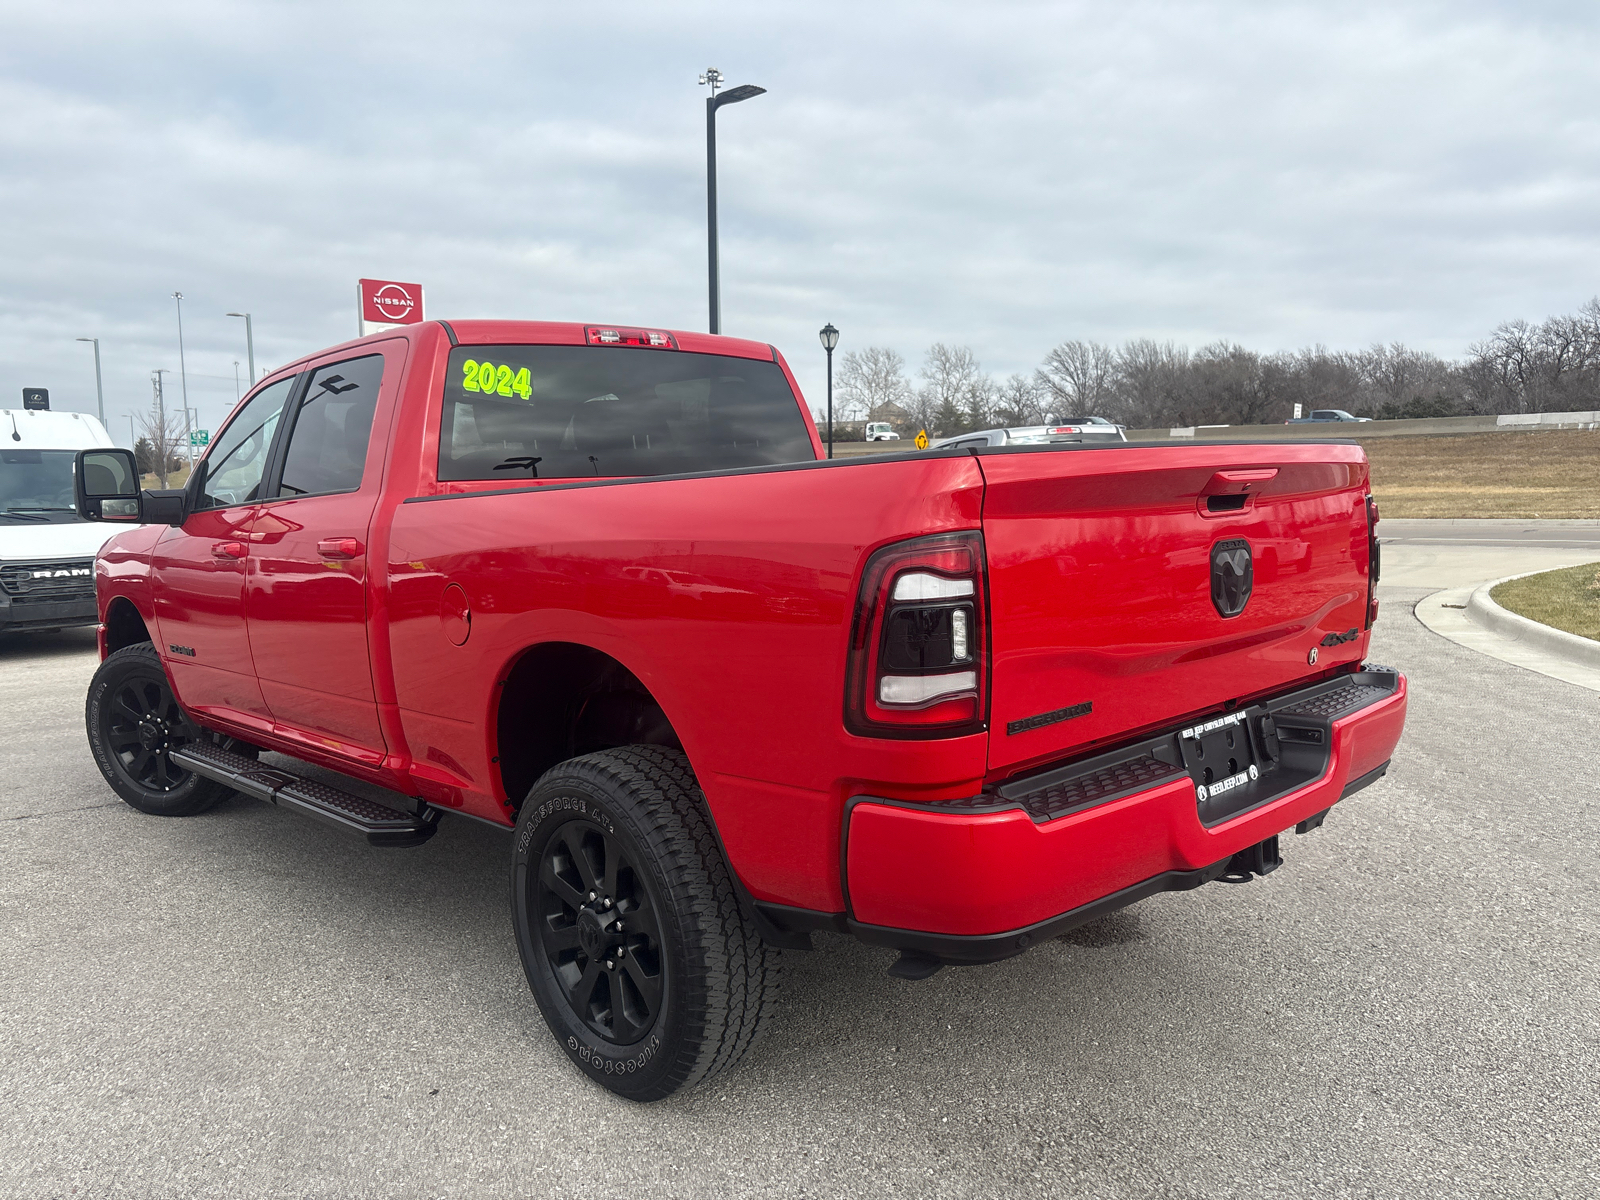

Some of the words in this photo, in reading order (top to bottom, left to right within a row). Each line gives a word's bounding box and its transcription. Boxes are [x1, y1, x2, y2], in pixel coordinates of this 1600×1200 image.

[374, 297, 414, 307] NISSAN
[463, 359, 532, 400] 2024
[1221, 541, 1245, 549] RAM
[33, 569, 90, 578] RAM
[1006, 701, 1093, 736] BIGHORN
[1204, 718, 1225, 731] CHRYSLER
[1224, 713, 1237, 725] DODGE
[1236, 710, 1247, 720] RAM
[1208, 771, 1249, 797] REEDJEEP.COM
[518, 797, 587, 855] TRANSFORCE
